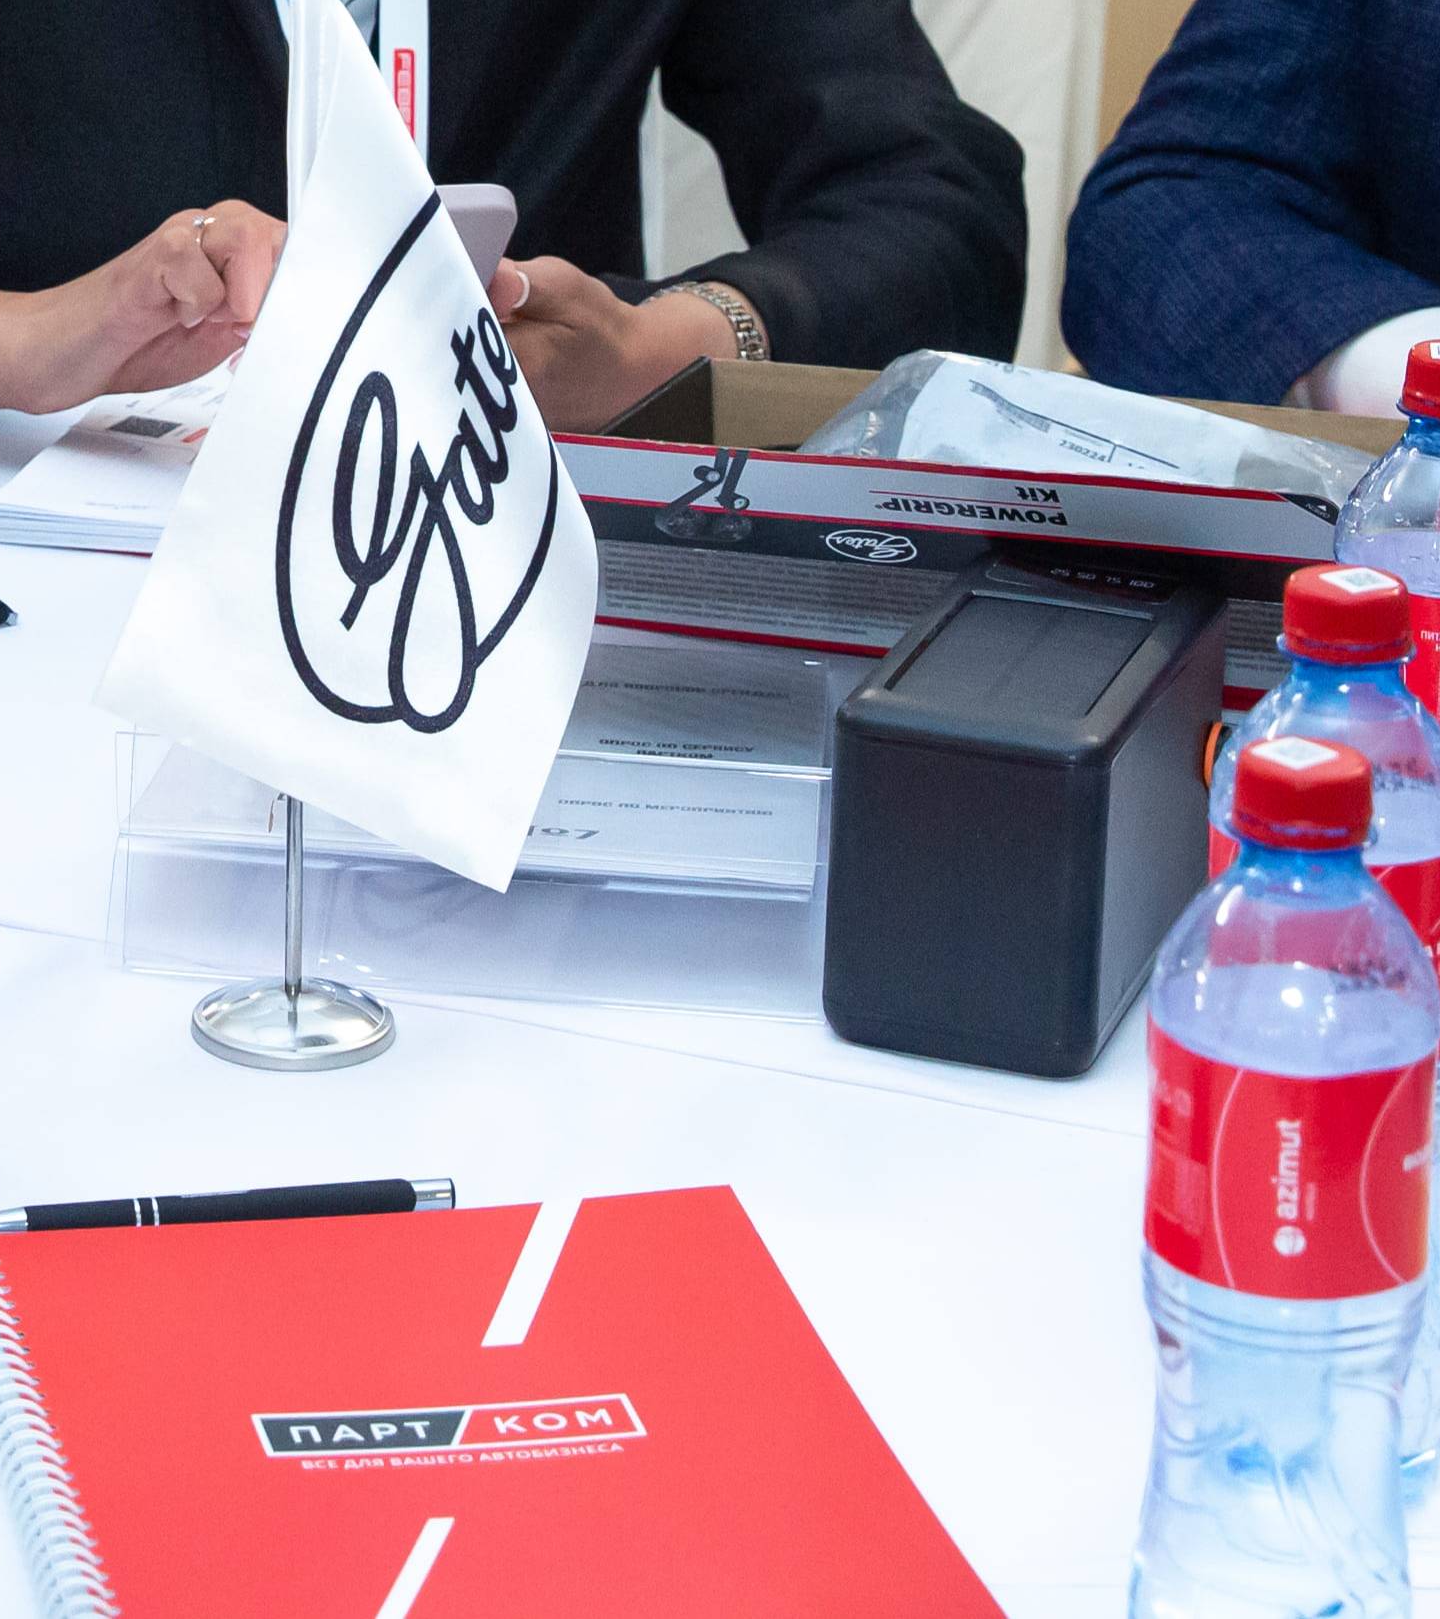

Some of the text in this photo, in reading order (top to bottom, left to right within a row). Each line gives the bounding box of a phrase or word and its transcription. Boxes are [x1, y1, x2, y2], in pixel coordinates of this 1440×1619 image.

[1014, 485, 1061, 504] Kit
[830, 530, 913, 561] Gates
[1270, 1119, 1302, 1222] azimut
[288, 1406, 614, 1444] ПАРТ КОМ
[300, 1442, 625, 1471] ВСЕ ДЛЯ ВАШЕГО АВТОБИЗНЕСА
